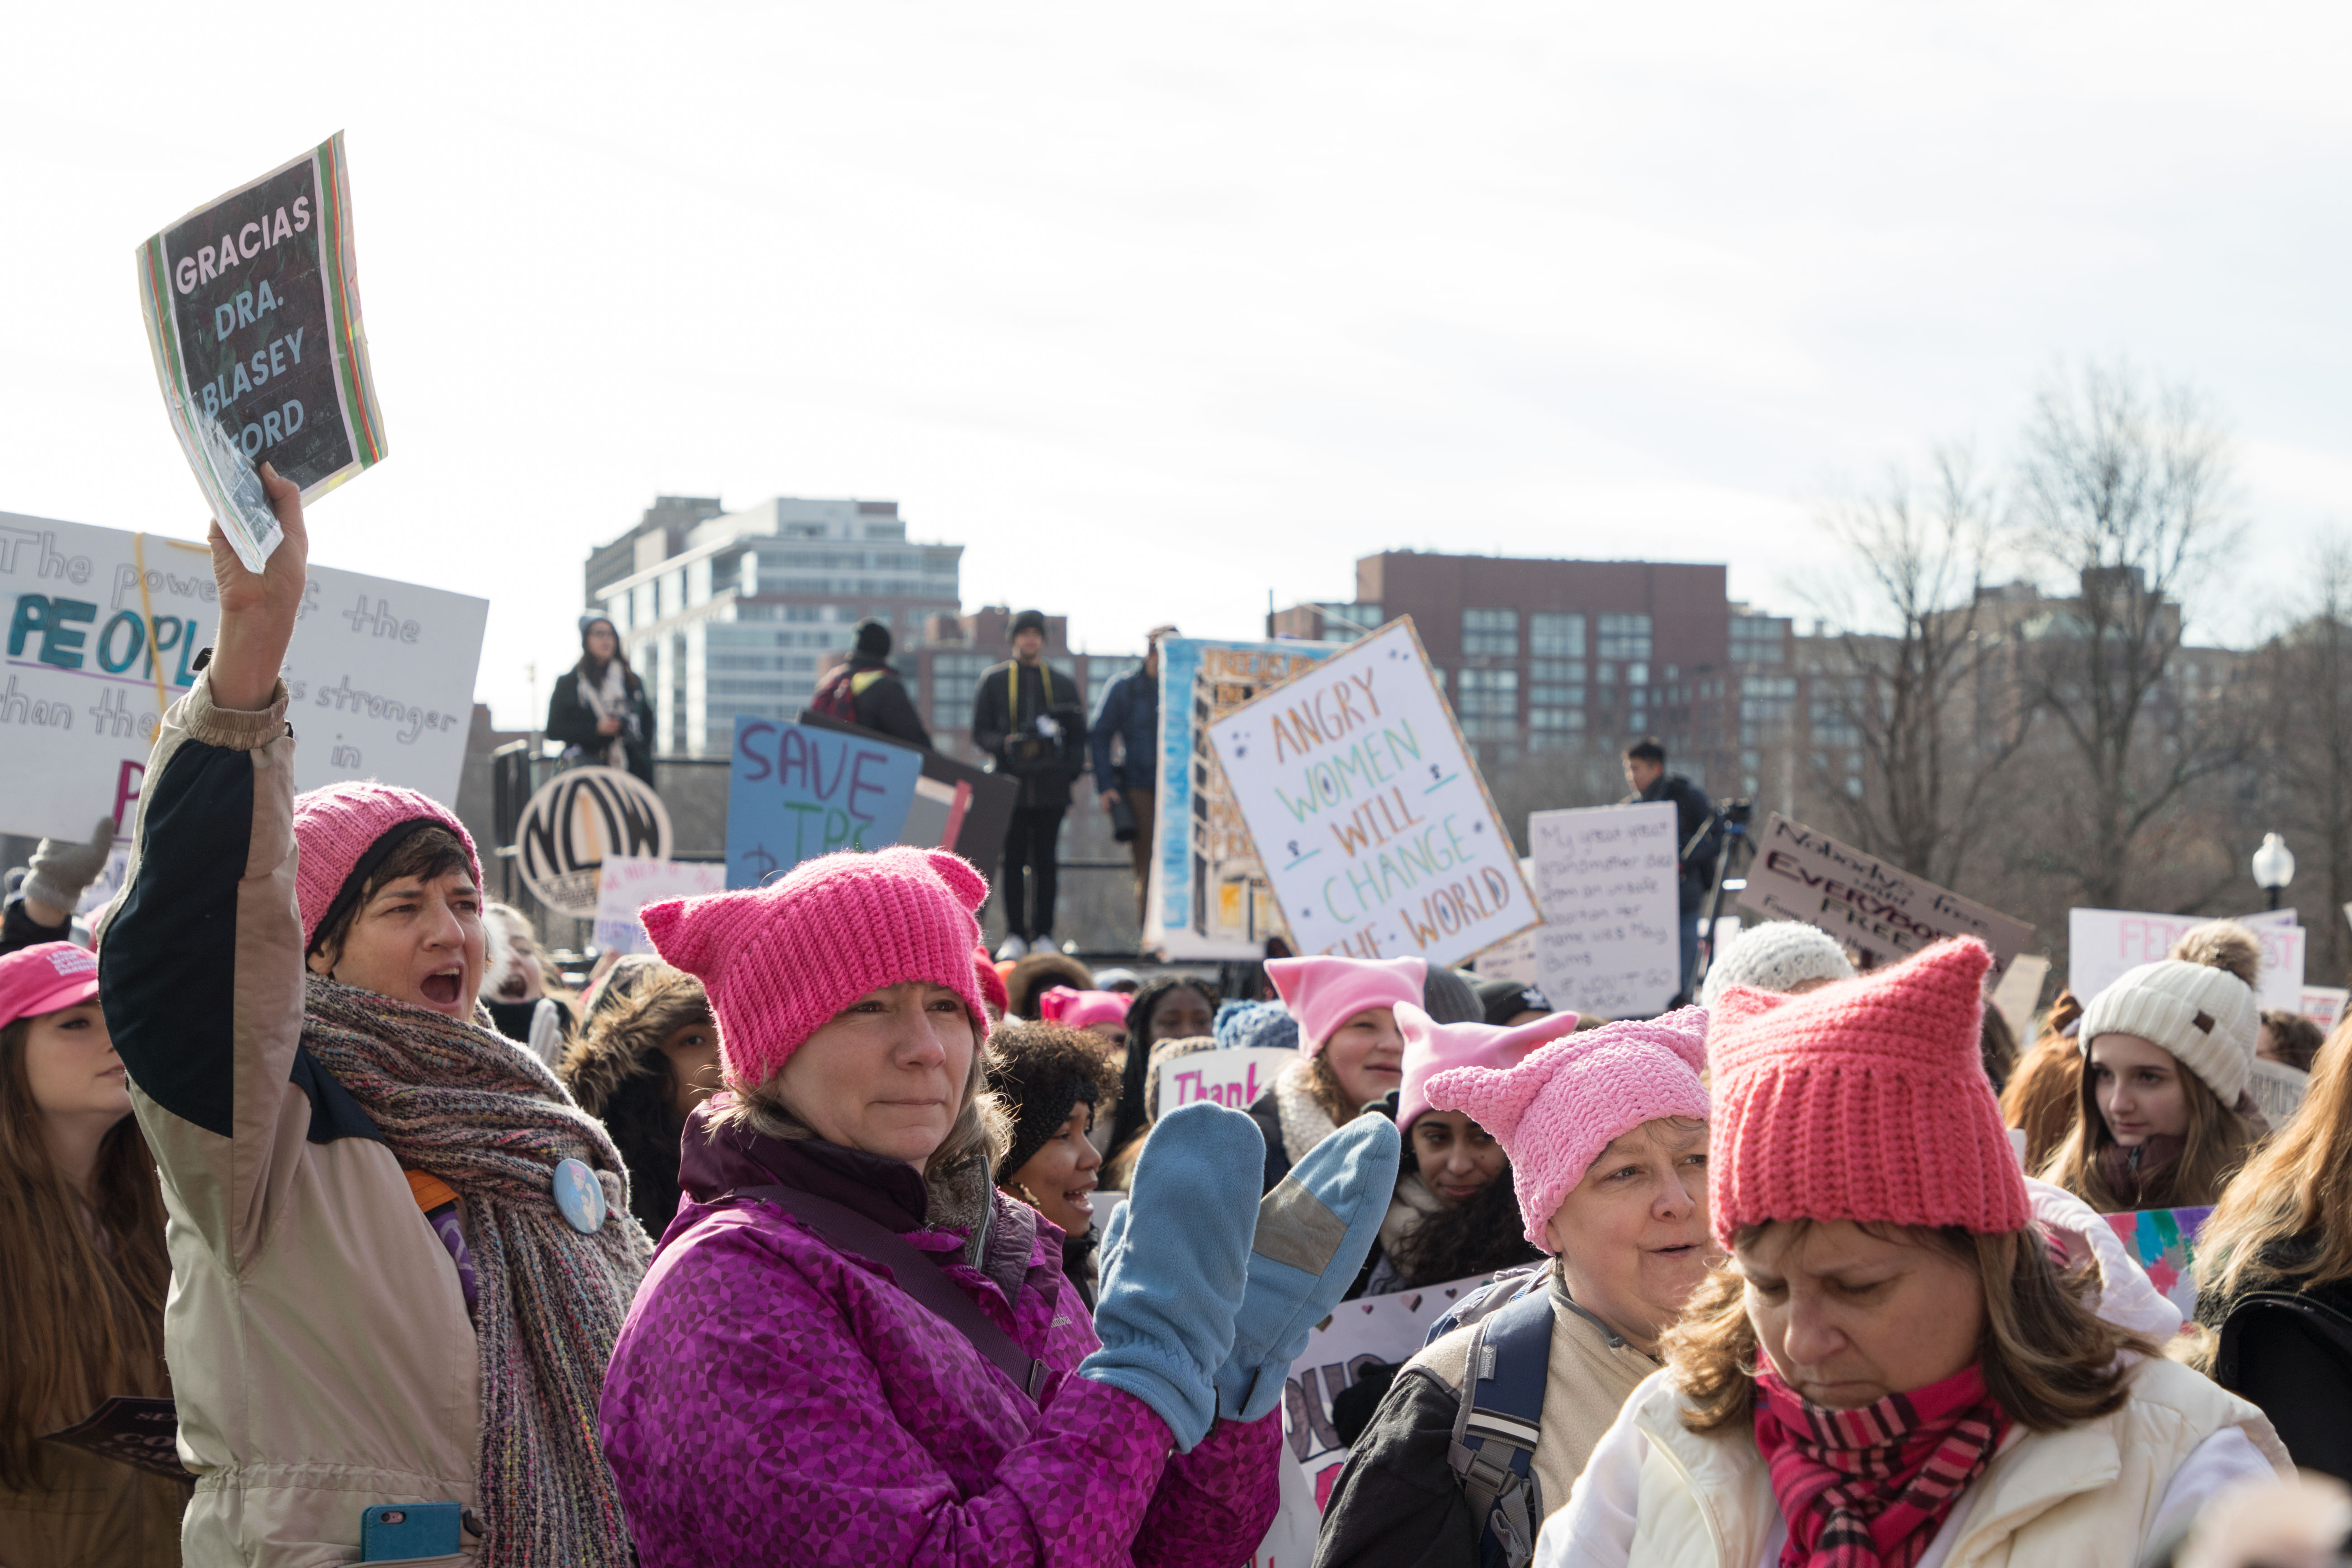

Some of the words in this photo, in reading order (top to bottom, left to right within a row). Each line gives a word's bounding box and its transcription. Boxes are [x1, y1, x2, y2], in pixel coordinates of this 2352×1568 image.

[176, 196, 310, 295] GRACIAS
[214, 280, 284, 342] DRA.
[201, 327, 304, 420] BLASEY
[0, 525, 93, 586] The
[111, 563, 219, 611] powe
[296, 580, 320, 619] f
[342, 594, 421, 643] the
[7, 593, 198, 687] PEOPL
[316, 674, 458, 745] stronger
[0, 675, 74, 730] han
[89, 687, 160, 739] the
[331, 733, 361, 769] in
[1271, 665, 1381, 765] ANGRY
[738, 721, 888, 822] SAVE
[1273, 717, 1421, 824] WOMEN
[525, 776, 660, 879] NOW
[1329, 785, 1425, 858] WILL
[1540, 824, 1575, 860] My
[1322, 813, 1476, 924] CHANGE
[1400, 866, 1510, 950] WORLD
[1767, 850, 1955, 940] EVERYBO
[1820, 897, 1912, 952] FREE
[2120, 918, 2298, 971] FEMST
[1174, 1061, 1261, 1108] Thank
[1050, 1313, 1072, 1328] umbia
[1483, 1354, 1492, 1378] Outdoor
